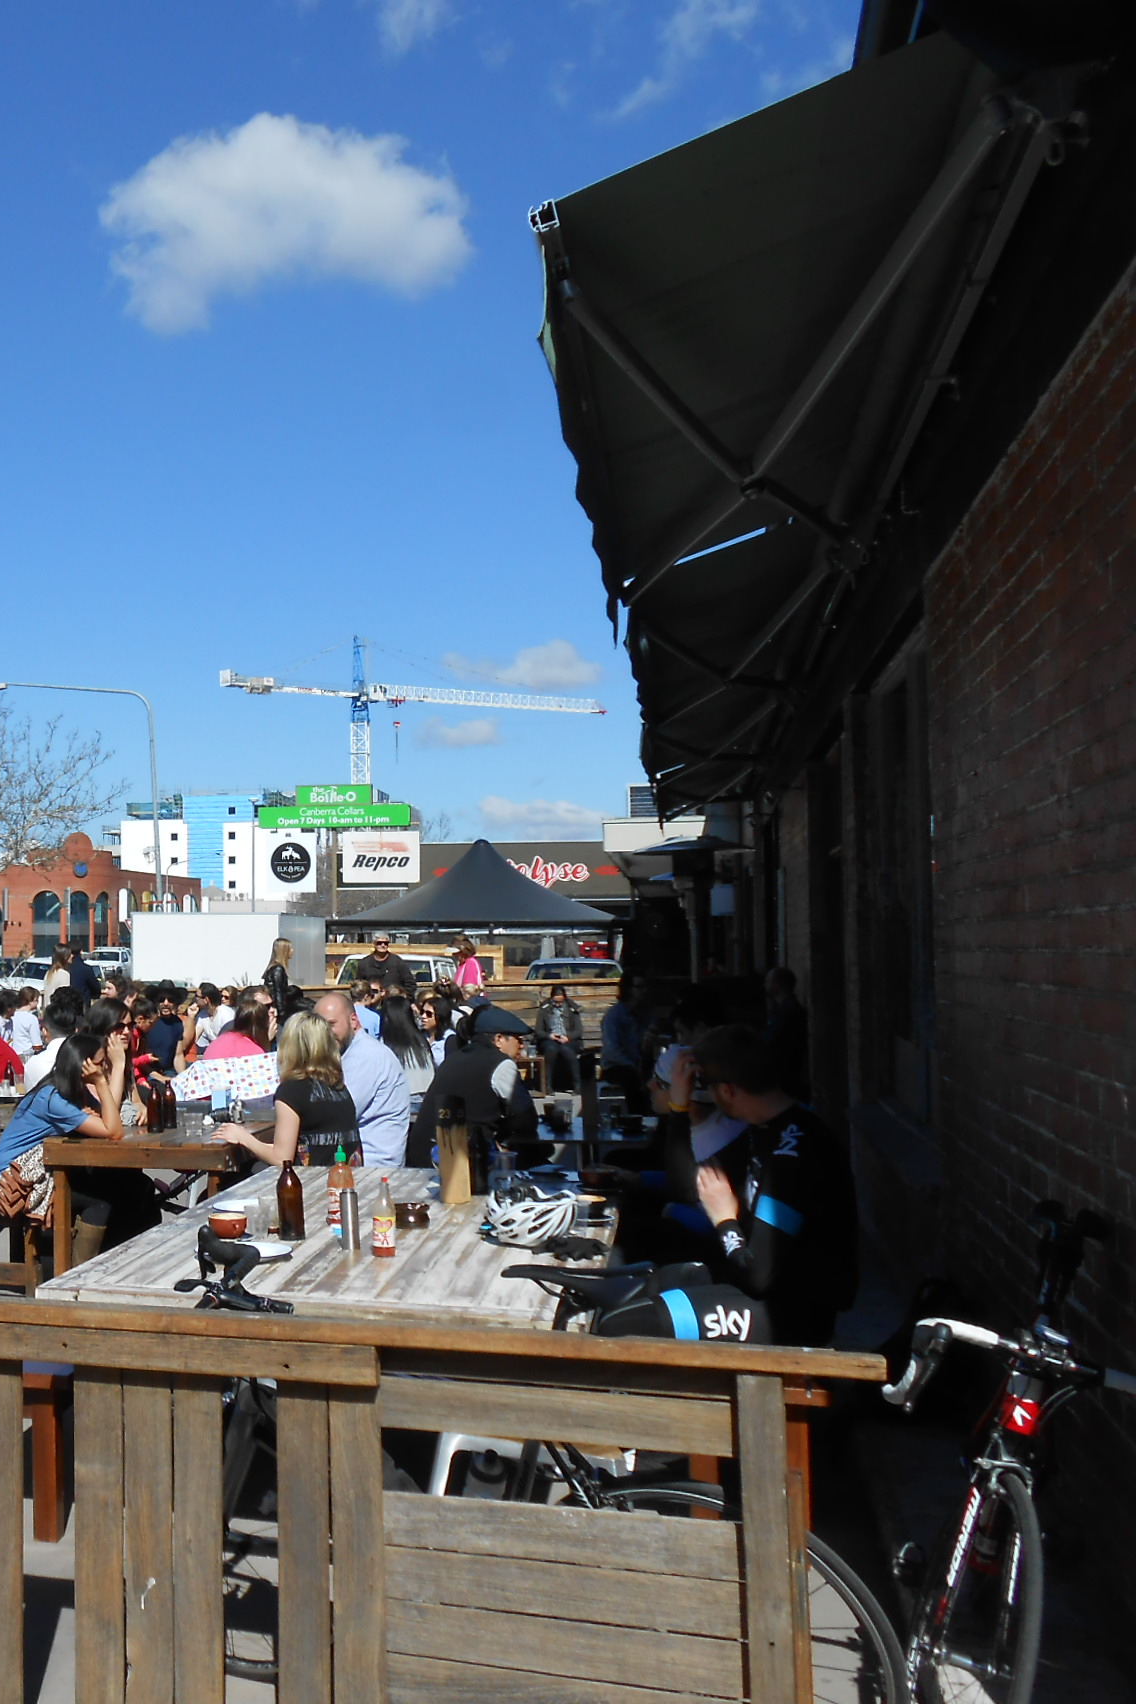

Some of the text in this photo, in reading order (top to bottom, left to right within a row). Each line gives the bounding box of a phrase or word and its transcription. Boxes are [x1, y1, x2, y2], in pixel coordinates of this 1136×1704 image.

[299, 806, 365, 816] Canberra Cellars
[277, 817, 299, 827] Open
[300, 816, 306, 825] 7
[306, 816, 326, 827] Days
[354, 816, 363, 824] to
[352, 854, 410, 872] Repco
[277, 865, 288, 873] ELK
[438, 1108, 451, 1119] 23
[704, 1304, 751, 1341] sky
